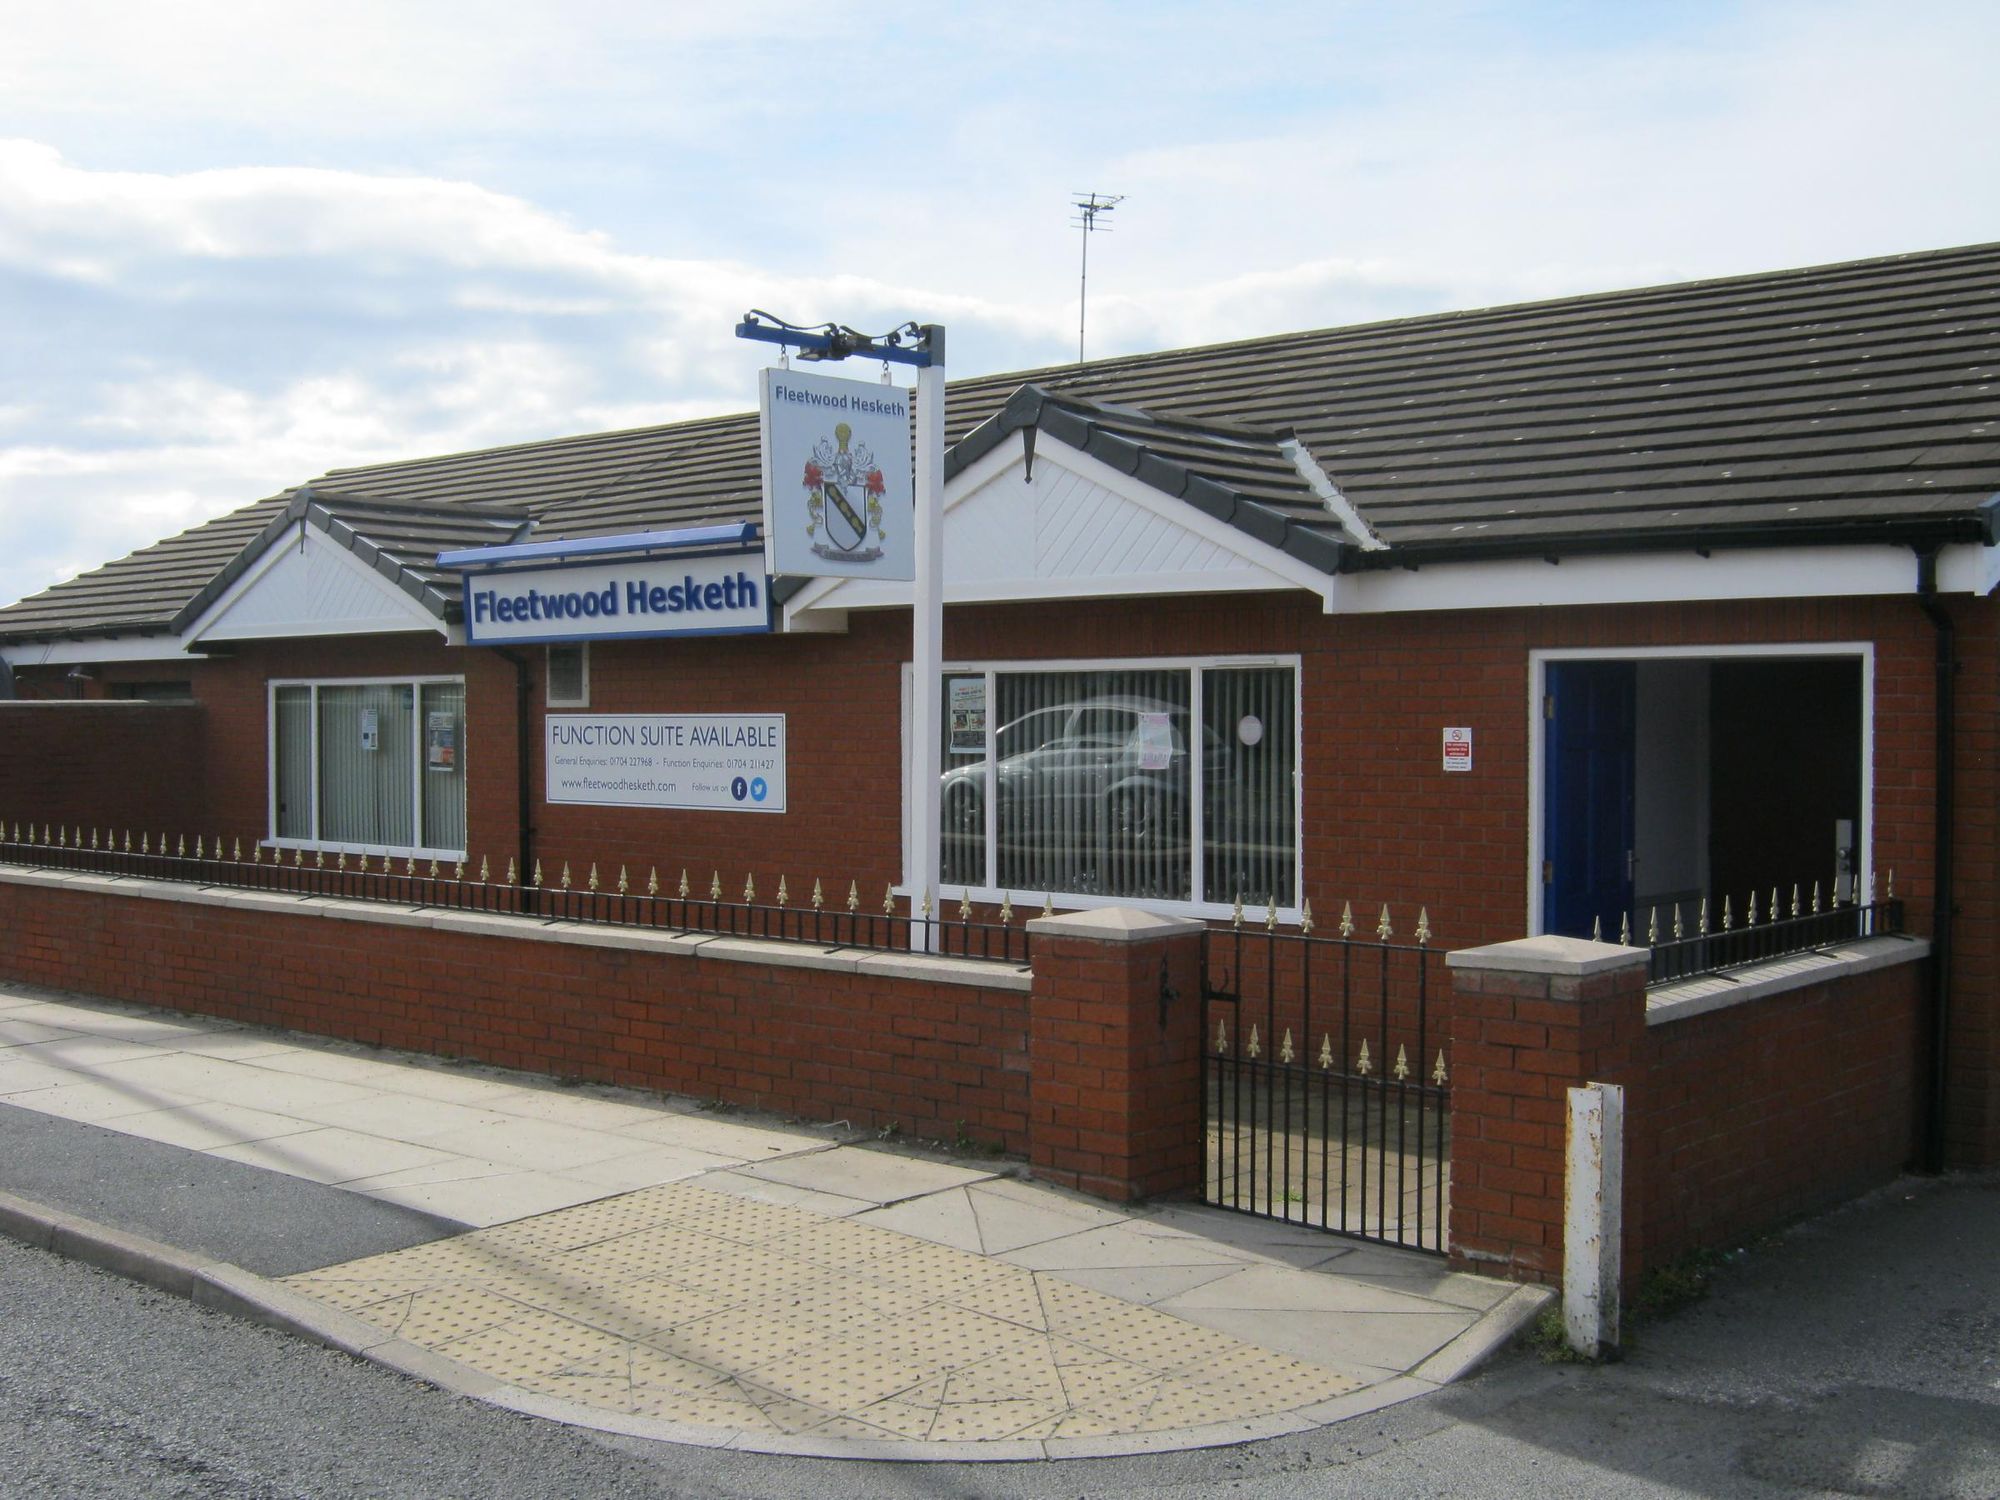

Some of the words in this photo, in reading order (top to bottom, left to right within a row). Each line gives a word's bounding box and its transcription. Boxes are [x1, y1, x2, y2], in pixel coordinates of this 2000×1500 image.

[775, 385, 848, 409] Fleetwood
[851, 396, 905, 417] Hesketh
[473, 581, 618, 623] Fleetwood
[626, 572, 758, 614] Hesketh
[552, 725, 635, 745] FUNCTION
[640, 726, 684, 746] SUITE
[689, 726, 777, 747] AVAILABLE
[554, 755, 578, 766] General
[609, 757, 628, 766] 01704
[629, 757, 653, 767] 227968
[662, 757, 691, 768] Function
[692, 758, 724, 770] Enquiries:
[726, 759, 747, 769] 01704
[749, 759, 775, 770] 211427
[561, 776, 677, 793] www.fleetwoodhesketh.com
[691, 782, 711, 792] Follow
[712, 783, 720, 792] us
[720, 784, 729, 793] on
